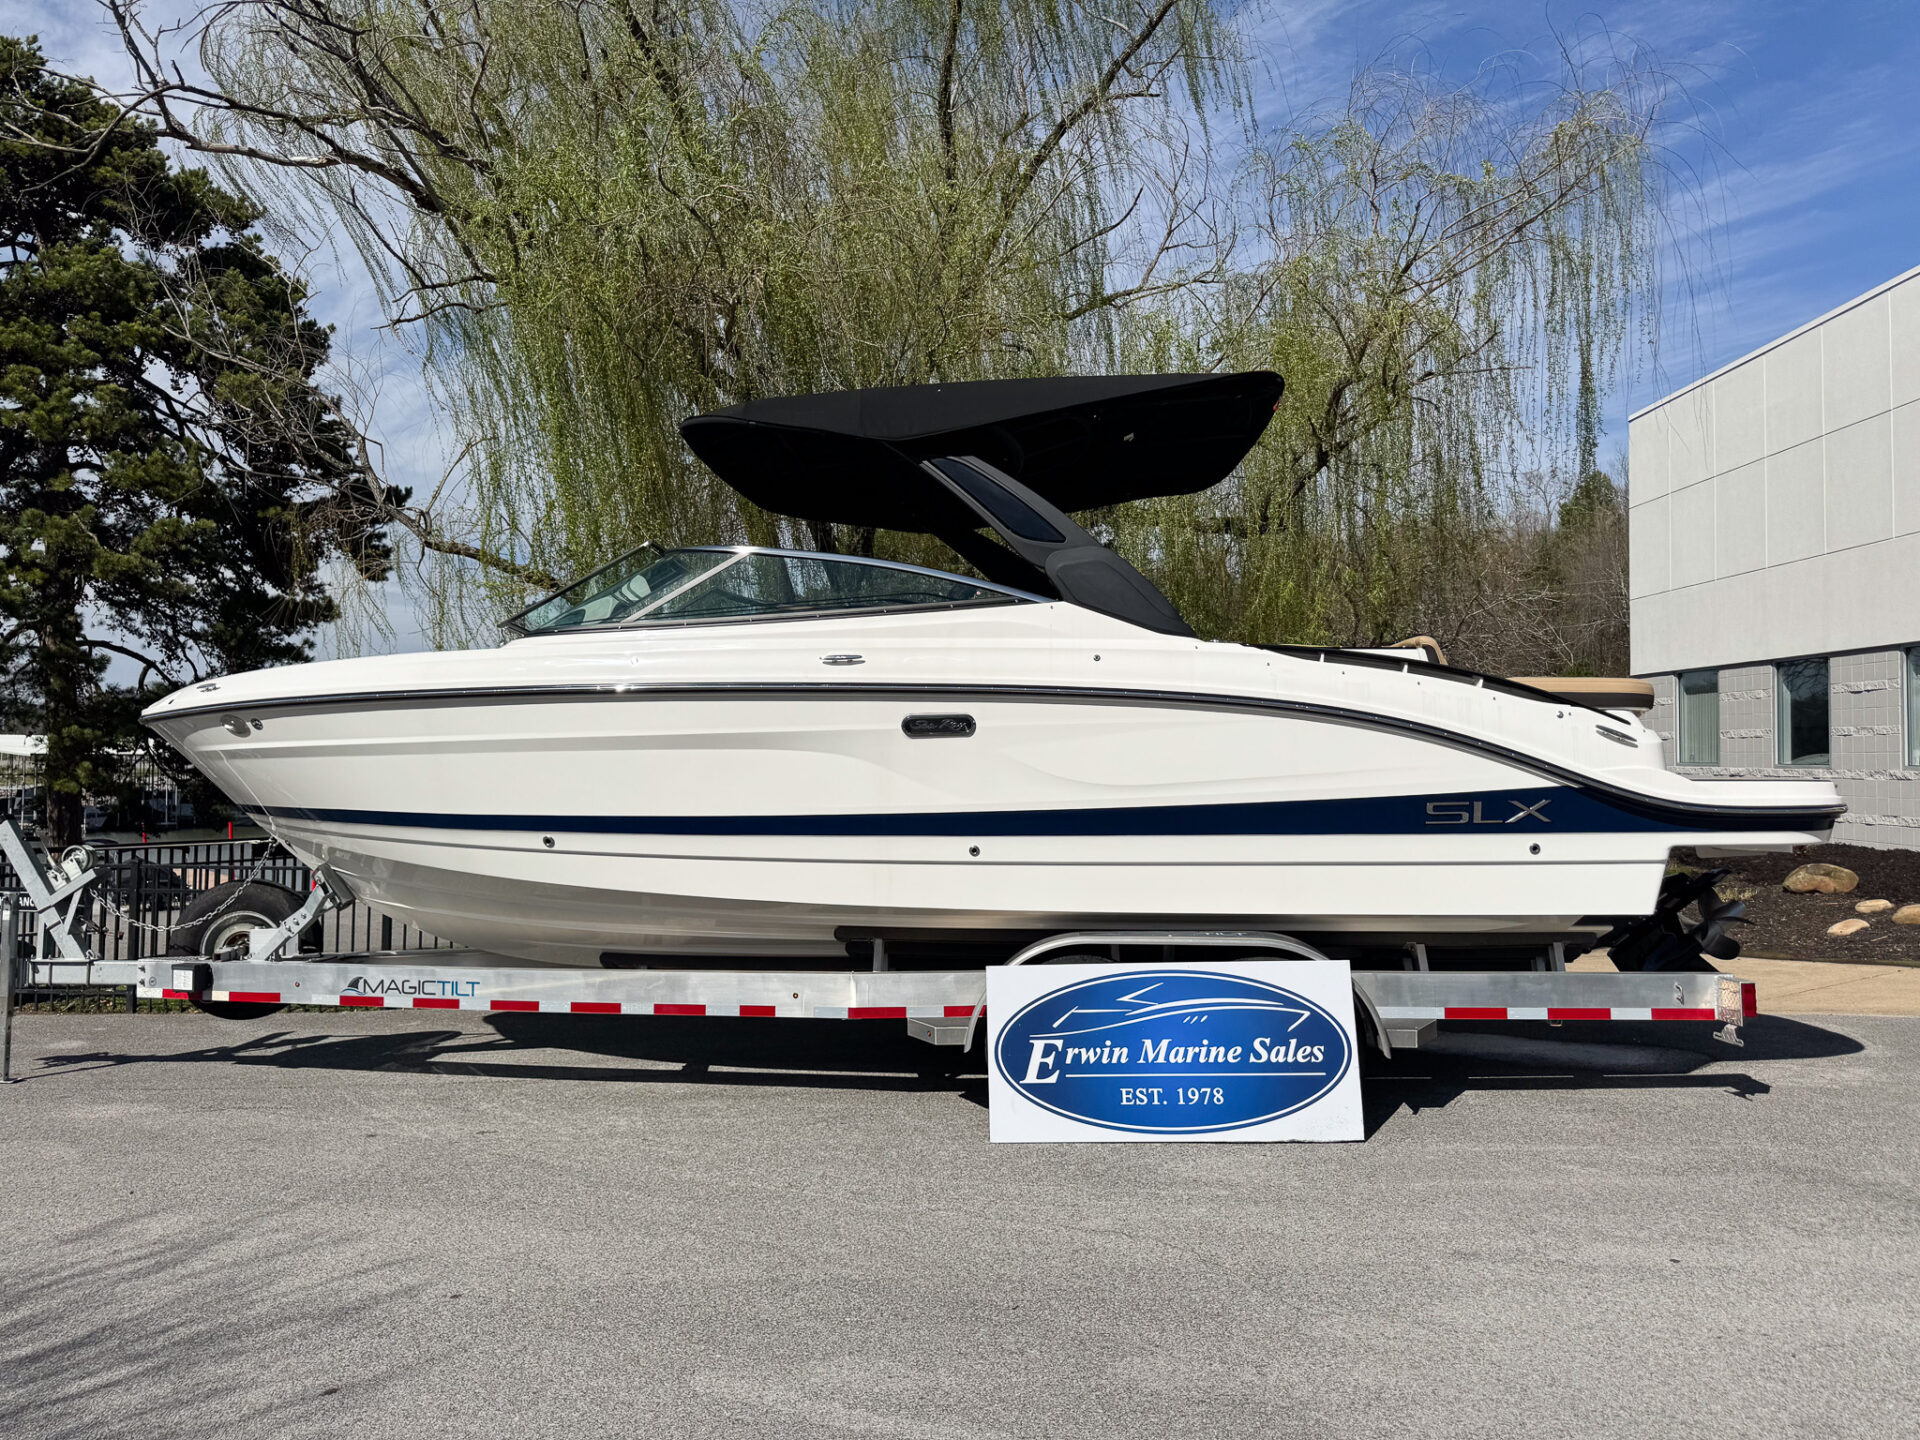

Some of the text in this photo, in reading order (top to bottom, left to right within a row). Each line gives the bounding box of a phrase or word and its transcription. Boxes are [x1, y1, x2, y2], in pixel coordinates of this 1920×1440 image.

[1425, 799, 1552, 825] SLX
[1019, 1037, 1325, 1084] Erwin Marine Sales
[1119, 1087, 1225, 1106] EST. 1978
